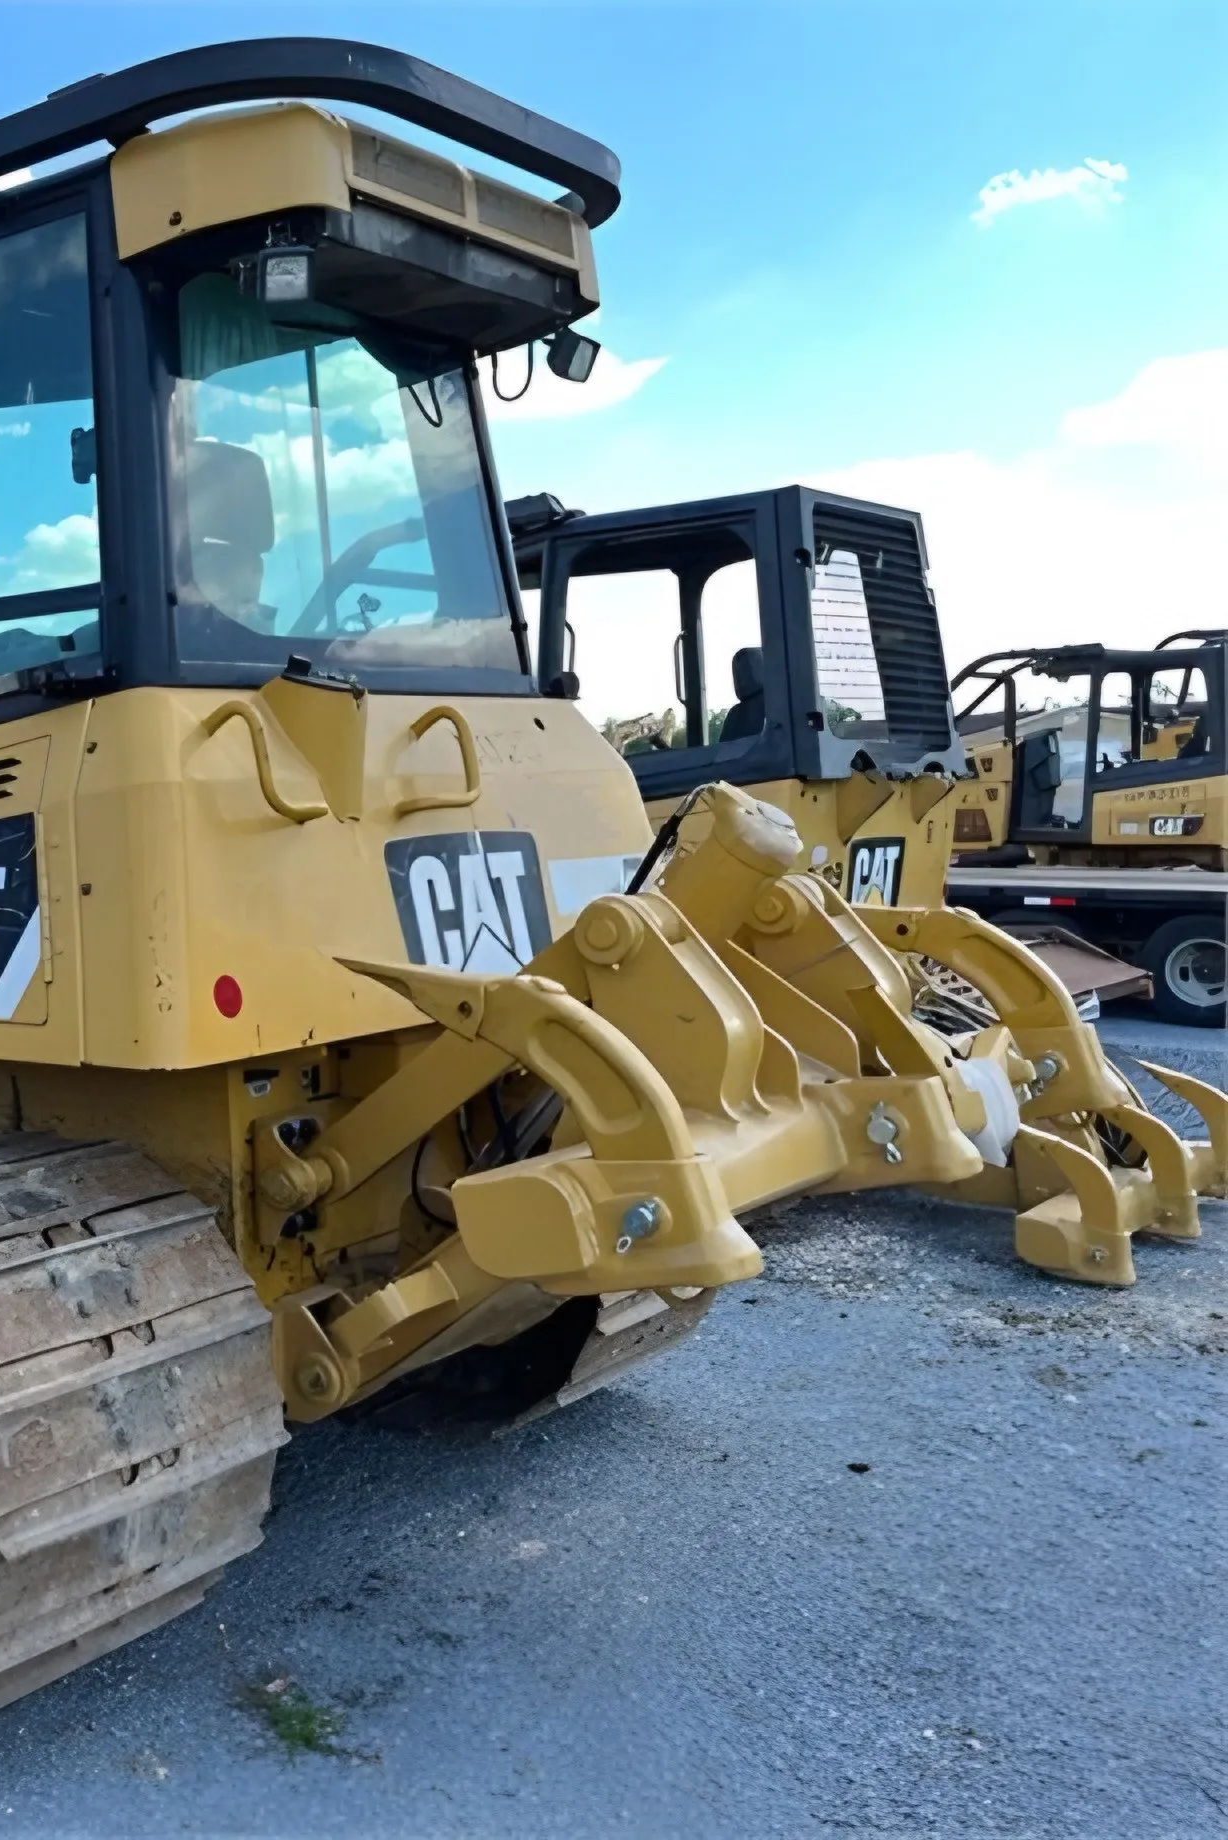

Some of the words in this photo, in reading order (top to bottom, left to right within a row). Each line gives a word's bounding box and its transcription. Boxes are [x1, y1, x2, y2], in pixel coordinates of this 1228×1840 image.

[1154, 817, 1185, 836] CAT
[851, 846, 901, 906] CAT
[409, 851, 534, 976] CAT
